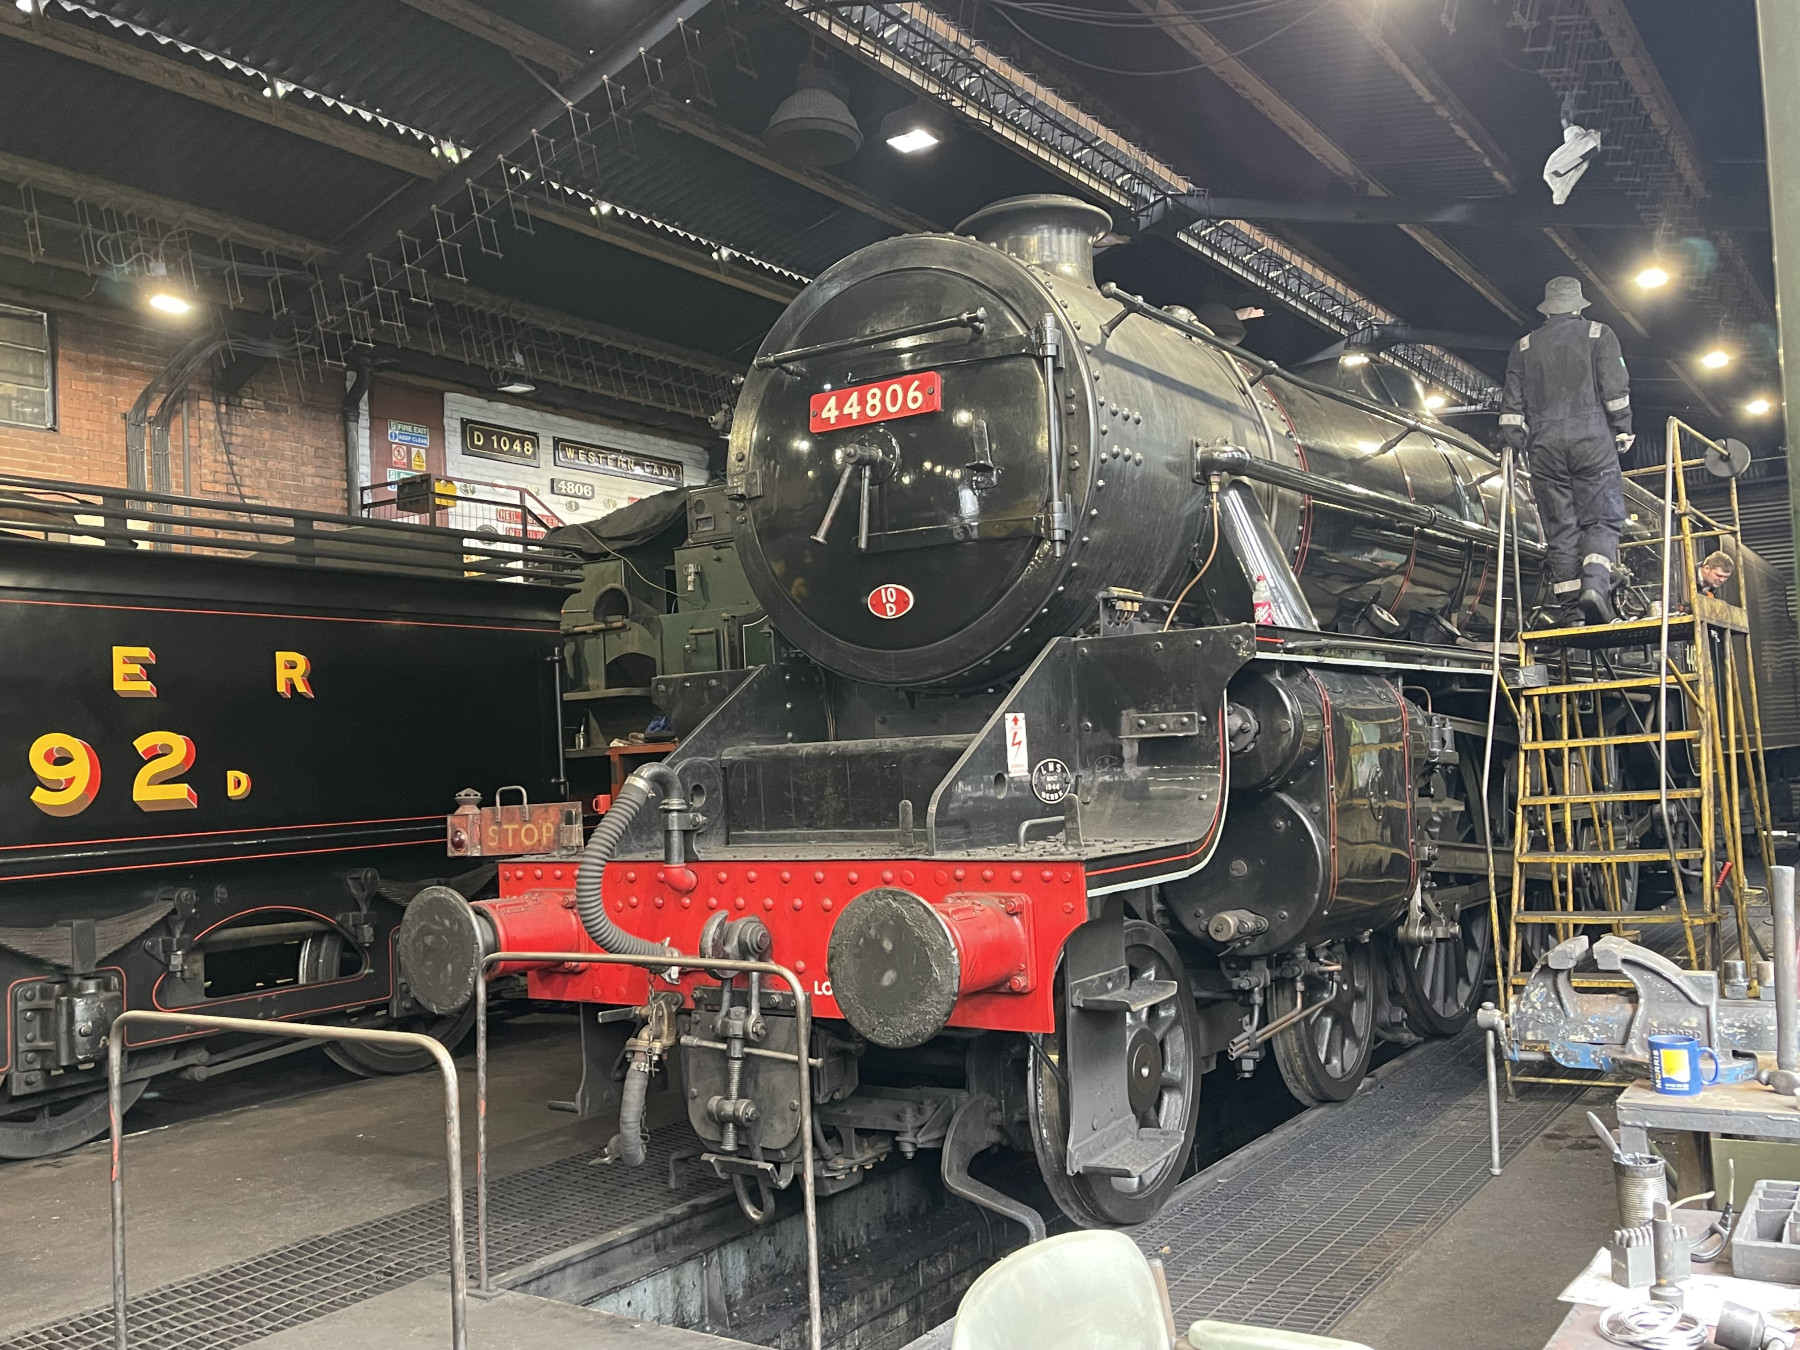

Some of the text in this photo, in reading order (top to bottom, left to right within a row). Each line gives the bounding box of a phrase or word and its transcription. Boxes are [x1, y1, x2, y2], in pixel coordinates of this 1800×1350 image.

[821, 379, 924, 424] 44806
[398, 423, 428, 435] FIRE EXIT
[473, 430, 534, 456] D 1048
[565, 447, 636, 471] WESTERN
[557, 480, 594, 499] 4806
[881, 587, 896, 604] 10
[886, 603, 896, 617] D
[1045, 783, 1060, 791] 1944
[488, 822, 555, 847] STOP
[1652, 1049, 1663, 1089] MORRIS
